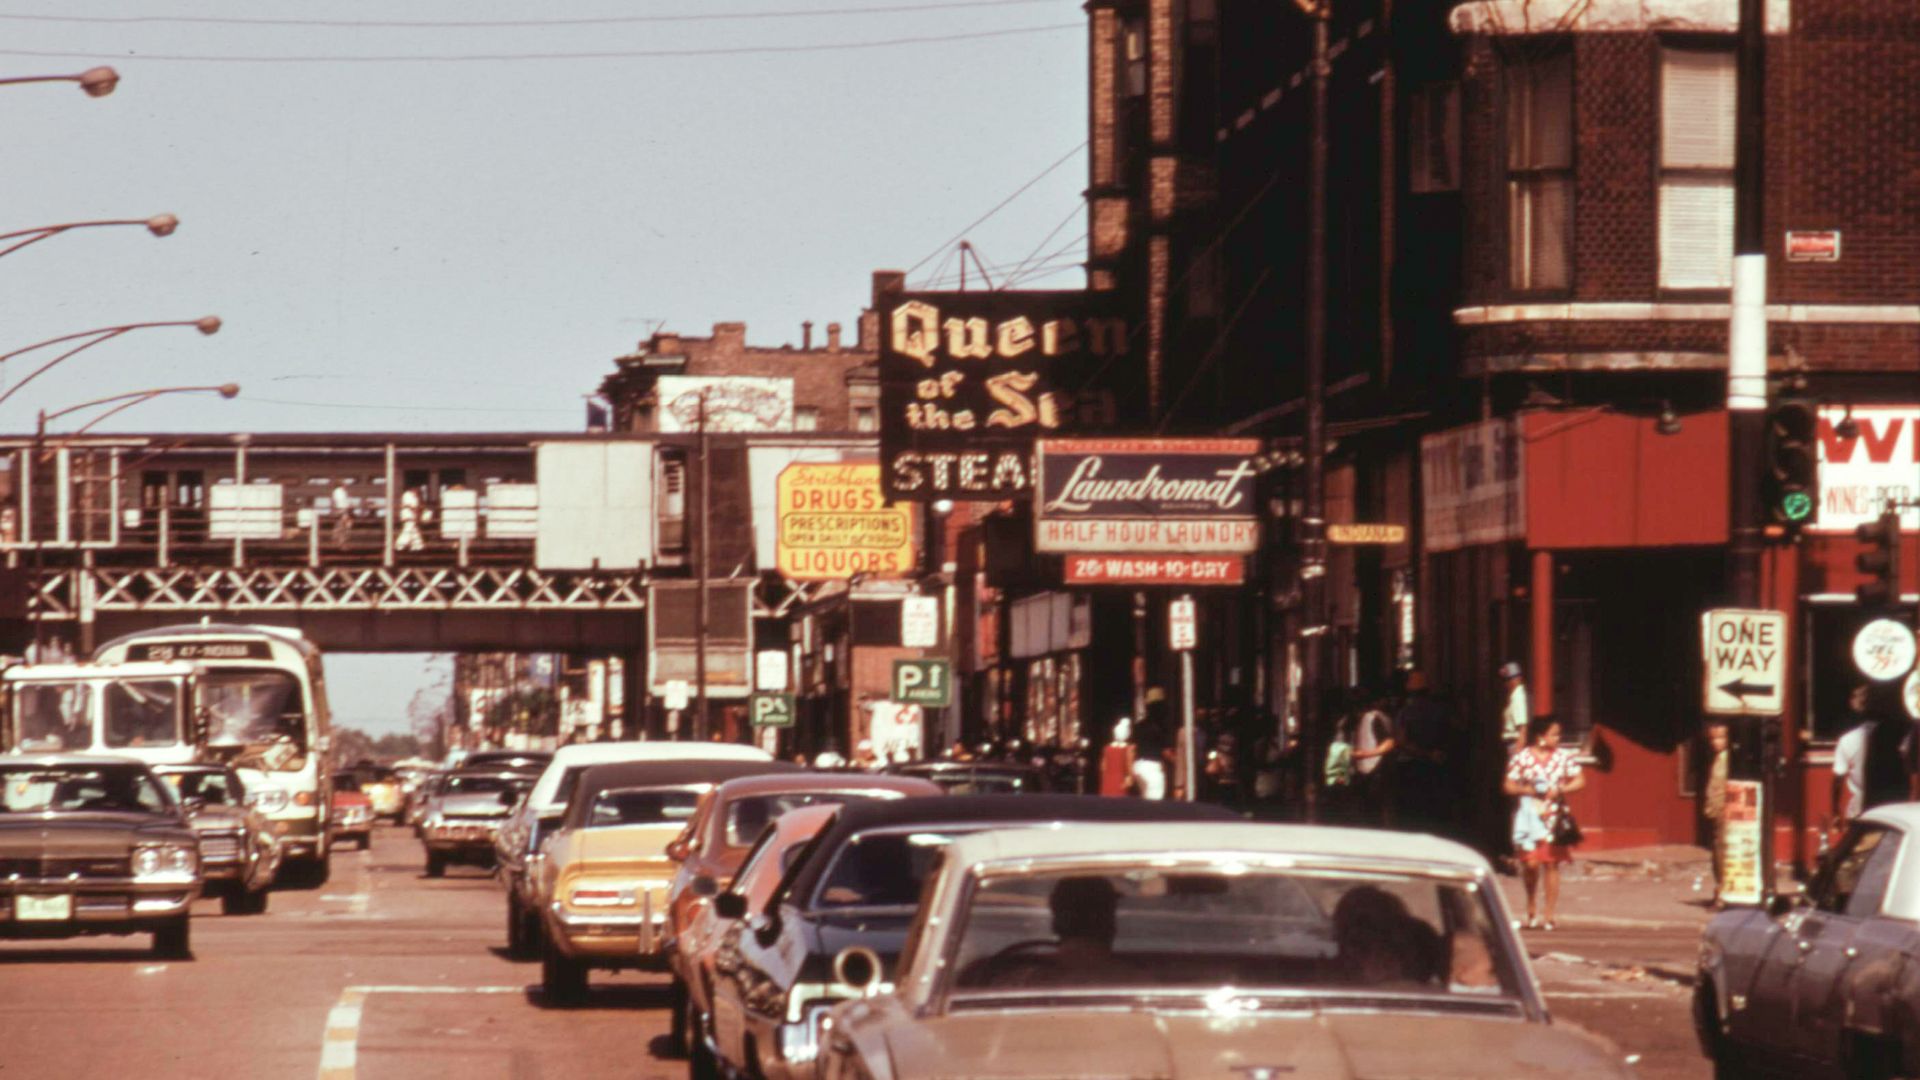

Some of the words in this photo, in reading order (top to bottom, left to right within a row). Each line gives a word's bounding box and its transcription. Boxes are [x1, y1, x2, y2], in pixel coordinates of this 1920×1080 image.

[918, 370, 964, 399] of
[907, 402, 977, 429] the
[893, 454, 1037, 491] STEA
[1044, 455, 1256, 512] Laundromat
[791, 489, 876, 510] DRUGS
[789, 516, 900, 532] PRESCRIPTIONS
[1049, 523, 1100, 542] HALF
[1106, 523, 1160, 543] HOUR
[1165, 523, 1259, 544] LAUNDRY
[791, 551, 898, 573] LIQUORS
[1718, 621, 1775, 645] ONE
[1715, 647, 1777, 671] WAY
